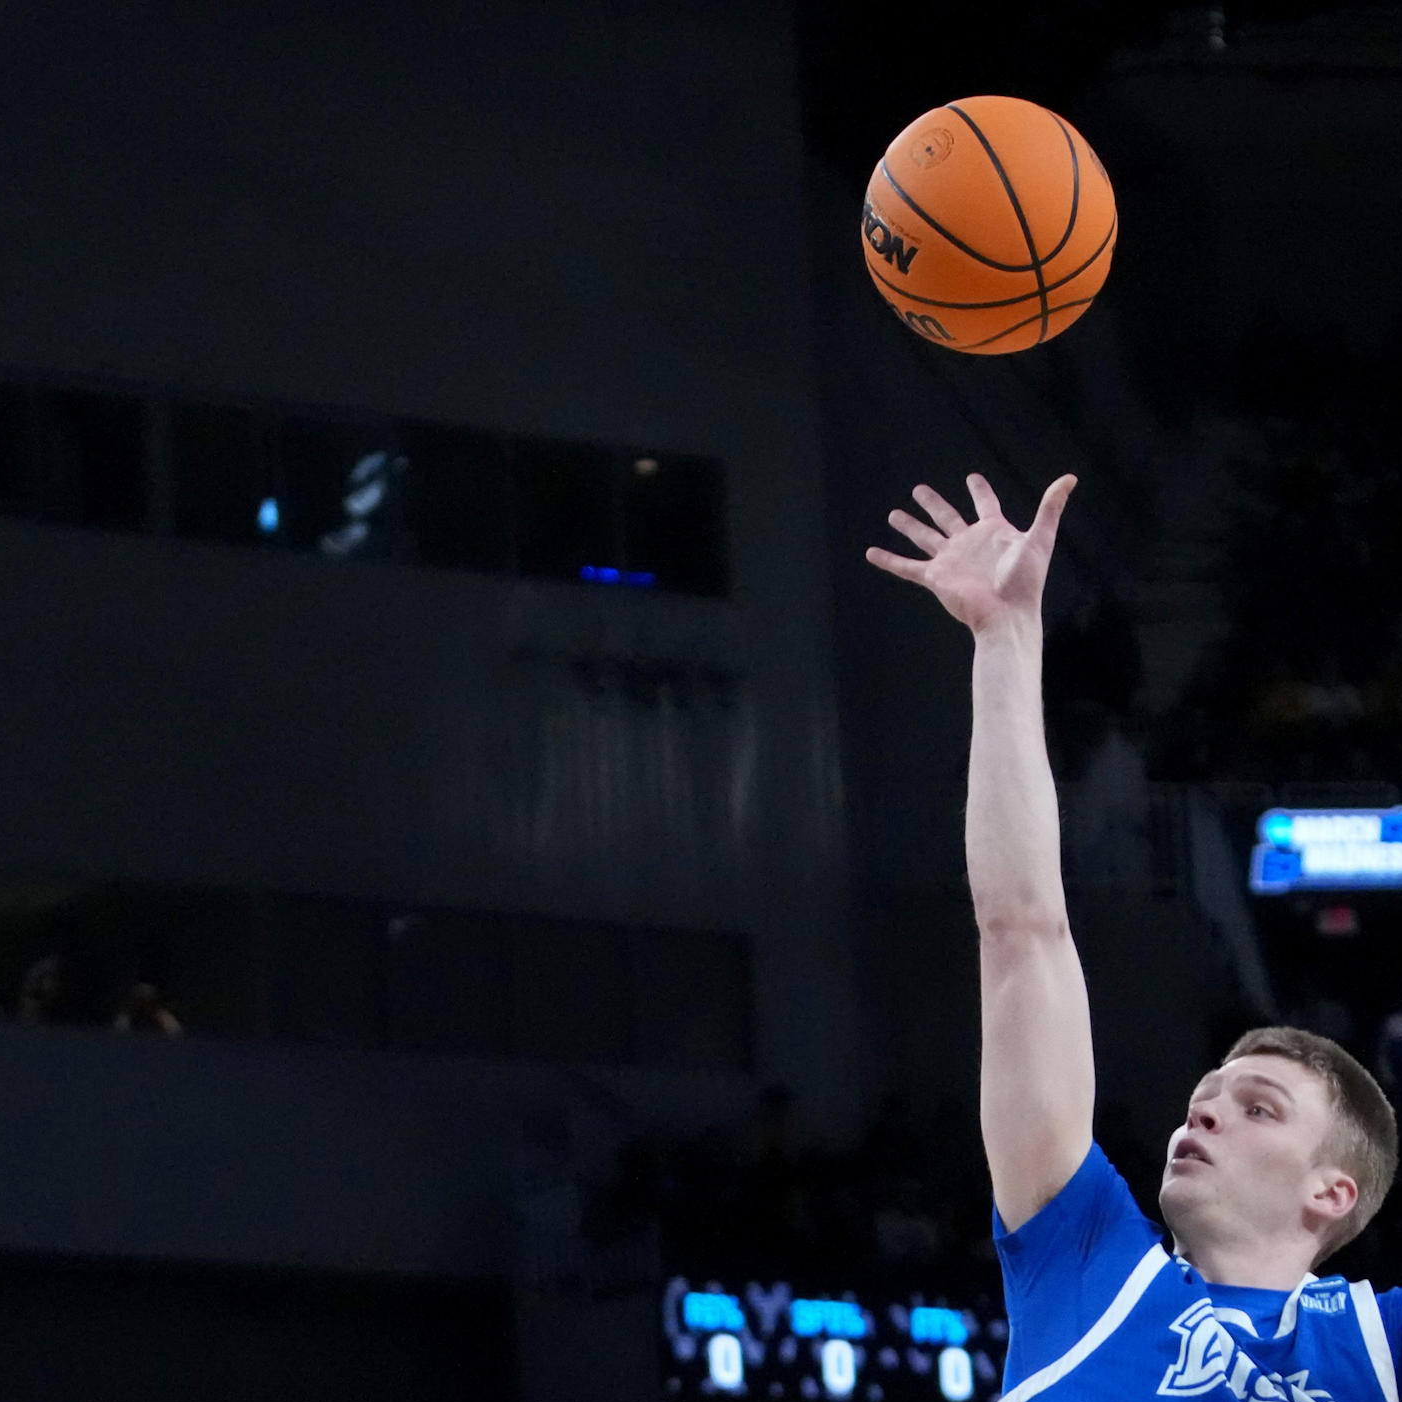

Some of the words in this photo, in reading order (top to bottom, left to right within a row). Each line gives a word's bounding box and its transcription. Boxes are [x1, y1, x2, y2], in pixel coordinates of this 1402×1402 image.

[708, 1333, 743, 1389] 0
[821, 1338, 856, 1395] 0
[939, 1346, 973, 1402] 0
